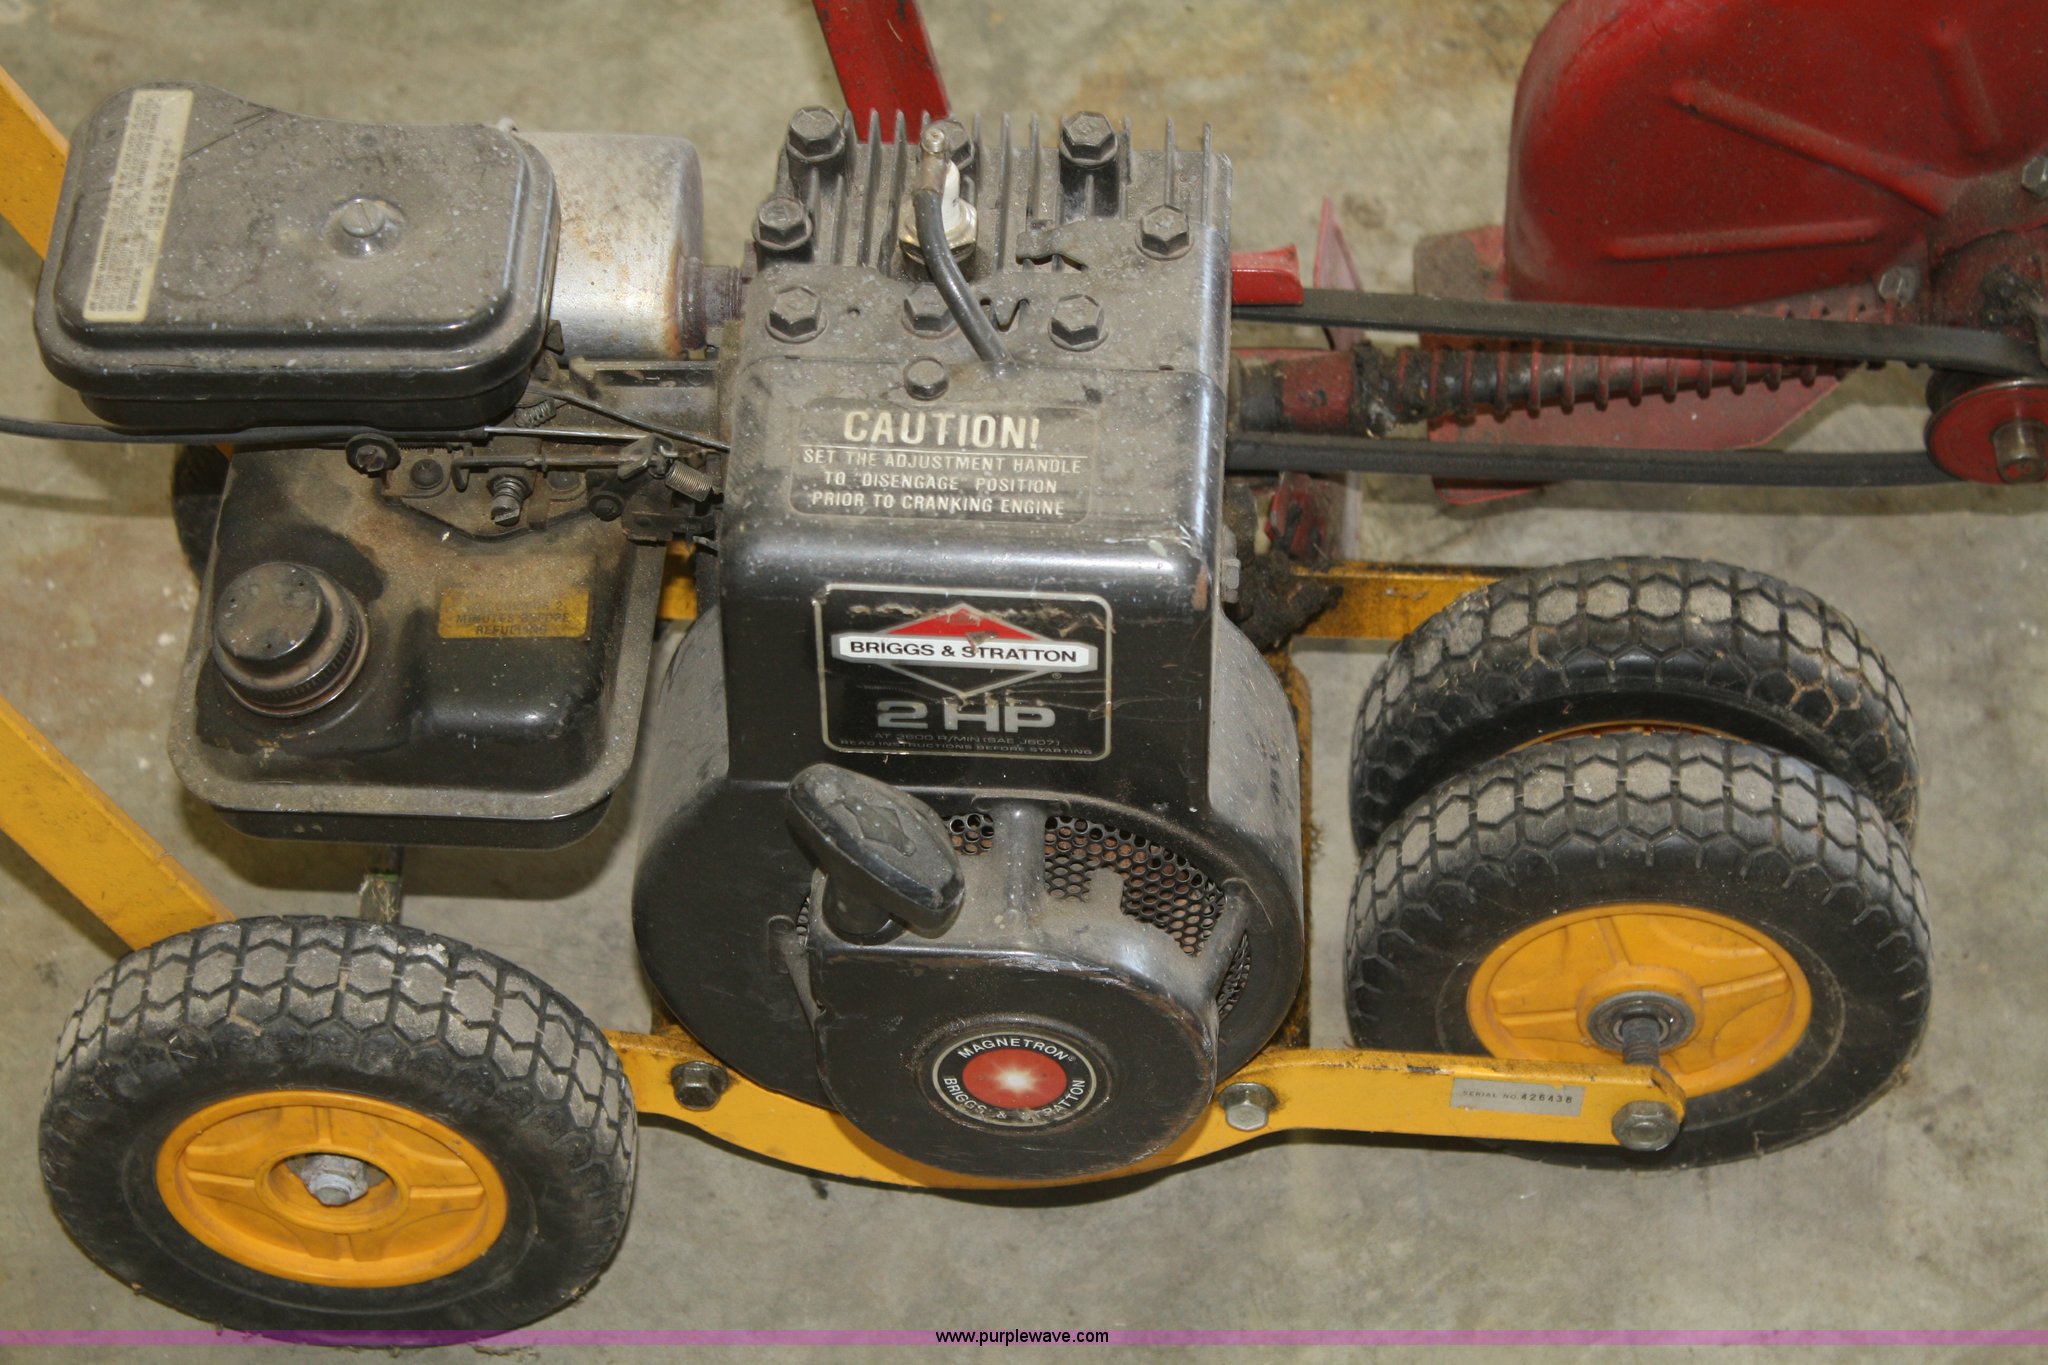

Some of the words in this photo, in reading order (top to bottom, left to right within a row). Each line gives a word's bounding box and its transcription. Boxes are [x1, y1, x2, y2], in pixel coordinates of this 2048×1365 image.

[843, 409, 1041, 450] CAUTION!
[803, 448, 835, 465] SET
[845, 450, 877, 467] THE
[885, 453, 1005, 472] ADJUSTMENT
[1012, 456, 1082, 474] HANDLE
[823, 470, 845, 486] TO
[975, 476, 1057, 494] POSITION
[811, 491, 864, 508] PRIOR
[873, 493, 894, 509] TO
[902, 494, 993, 513] CRANKING
[1000, 498, 1065, 516] ENGINE
[850, 640, 936, 657] BRIGGS
[940, 644, 956, 658] &
[961, 645, 1077, 663] STRATTON
[876, 699, 929, 729] 2
[943, 702, 1056, 734] HP
[840, 738, 875, 747] READ
[879, 740, 973, 751] INSTRUCTIONS
[976, 744, 1026, 753] BEFORE
[1029, 746, 1094, 756] STARTING
[874, 732, 891, 740] AT
[896, 733, 934, 742] 3600
[937, 734, 980, 744] R/MIN
[942, 1076, 988, 1116] BRIGGS
[995, 1109, 1008, 1120] &
